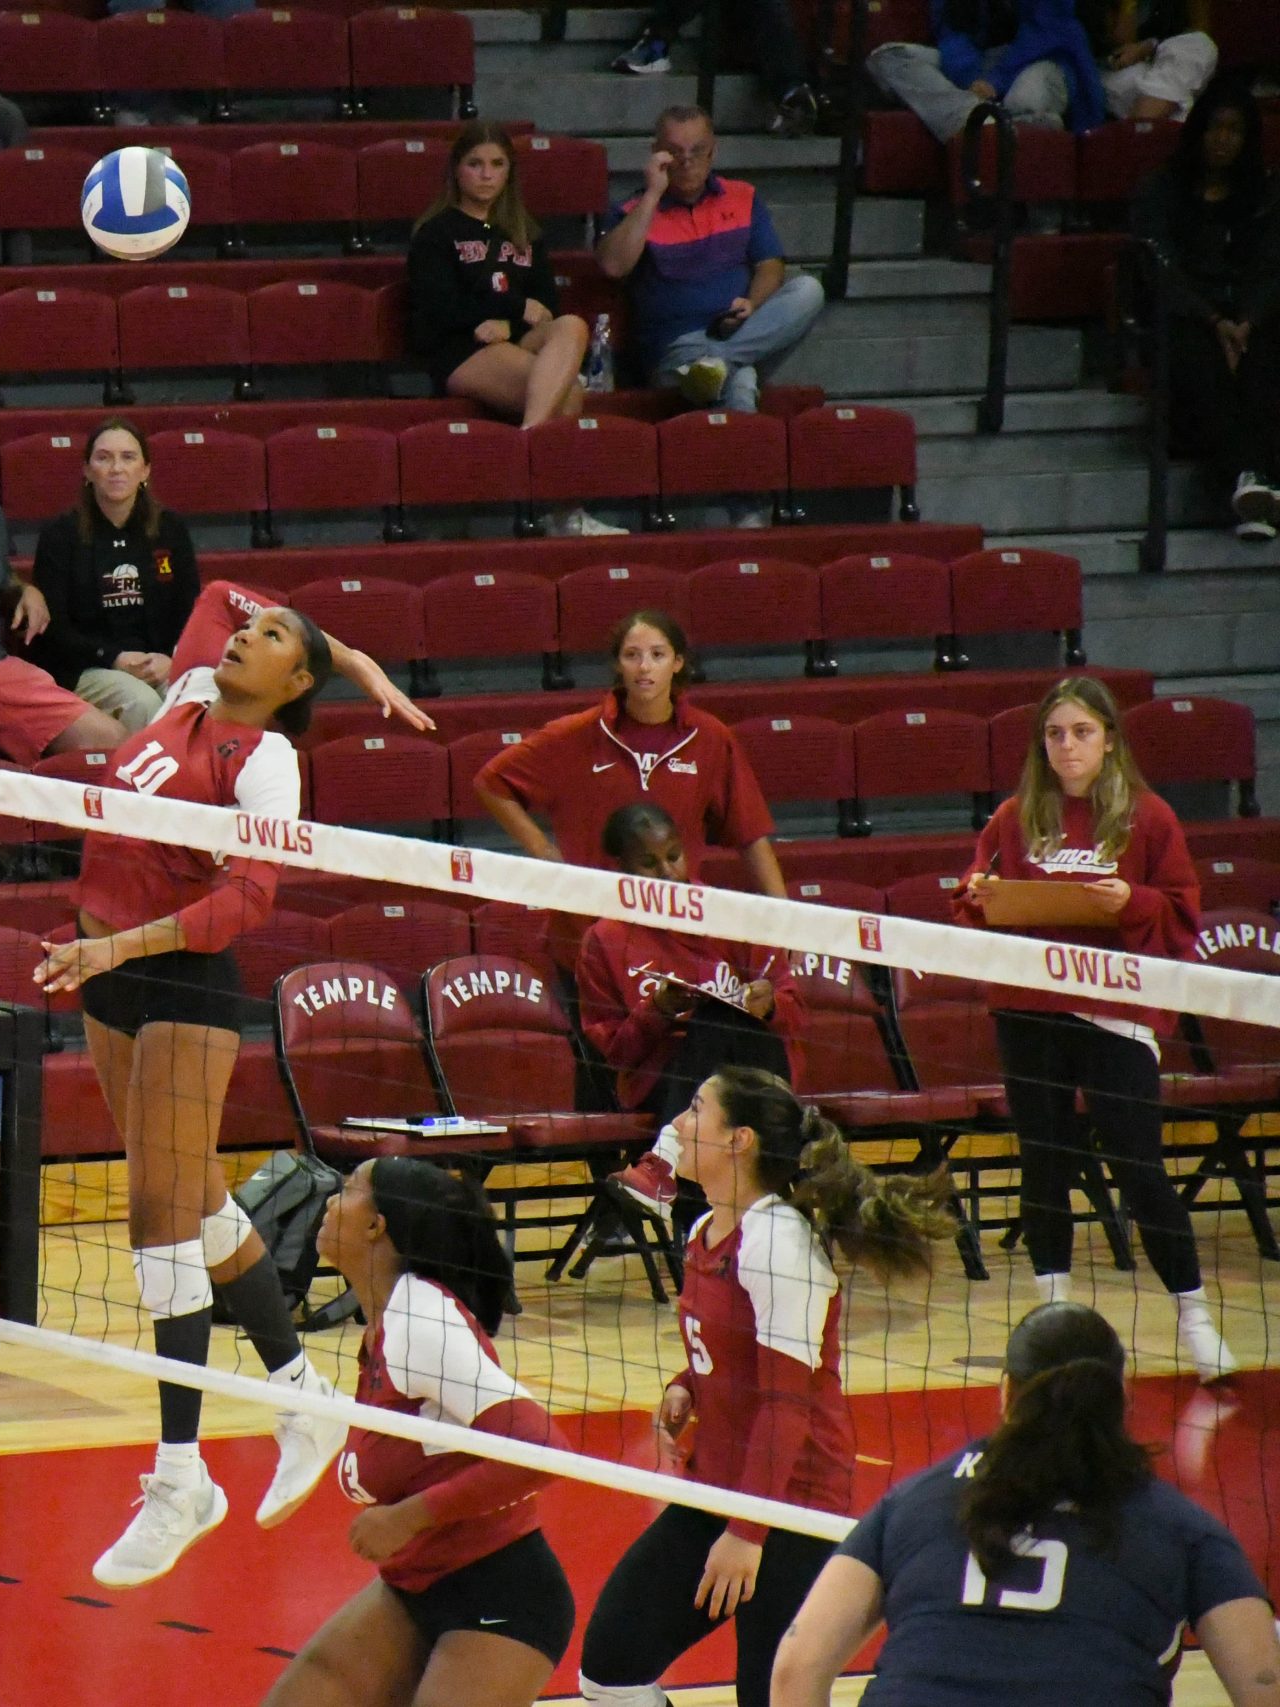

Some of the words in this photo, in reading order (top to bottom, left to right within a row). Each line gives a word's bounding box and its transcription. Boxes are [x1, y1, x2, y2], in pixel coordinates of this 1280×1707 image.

[116, 740, 180, 797] 10
[236, 813, 314, 855] OWLS
[619, 878, 704, 922] OWLS
[442, 970, 543, 1008] TEMPLE
[791, 953, 852, 986] PLE
[1045, 944, 1142, 992] OWLS
[294, 977, 397, 1017] TEMPLE
